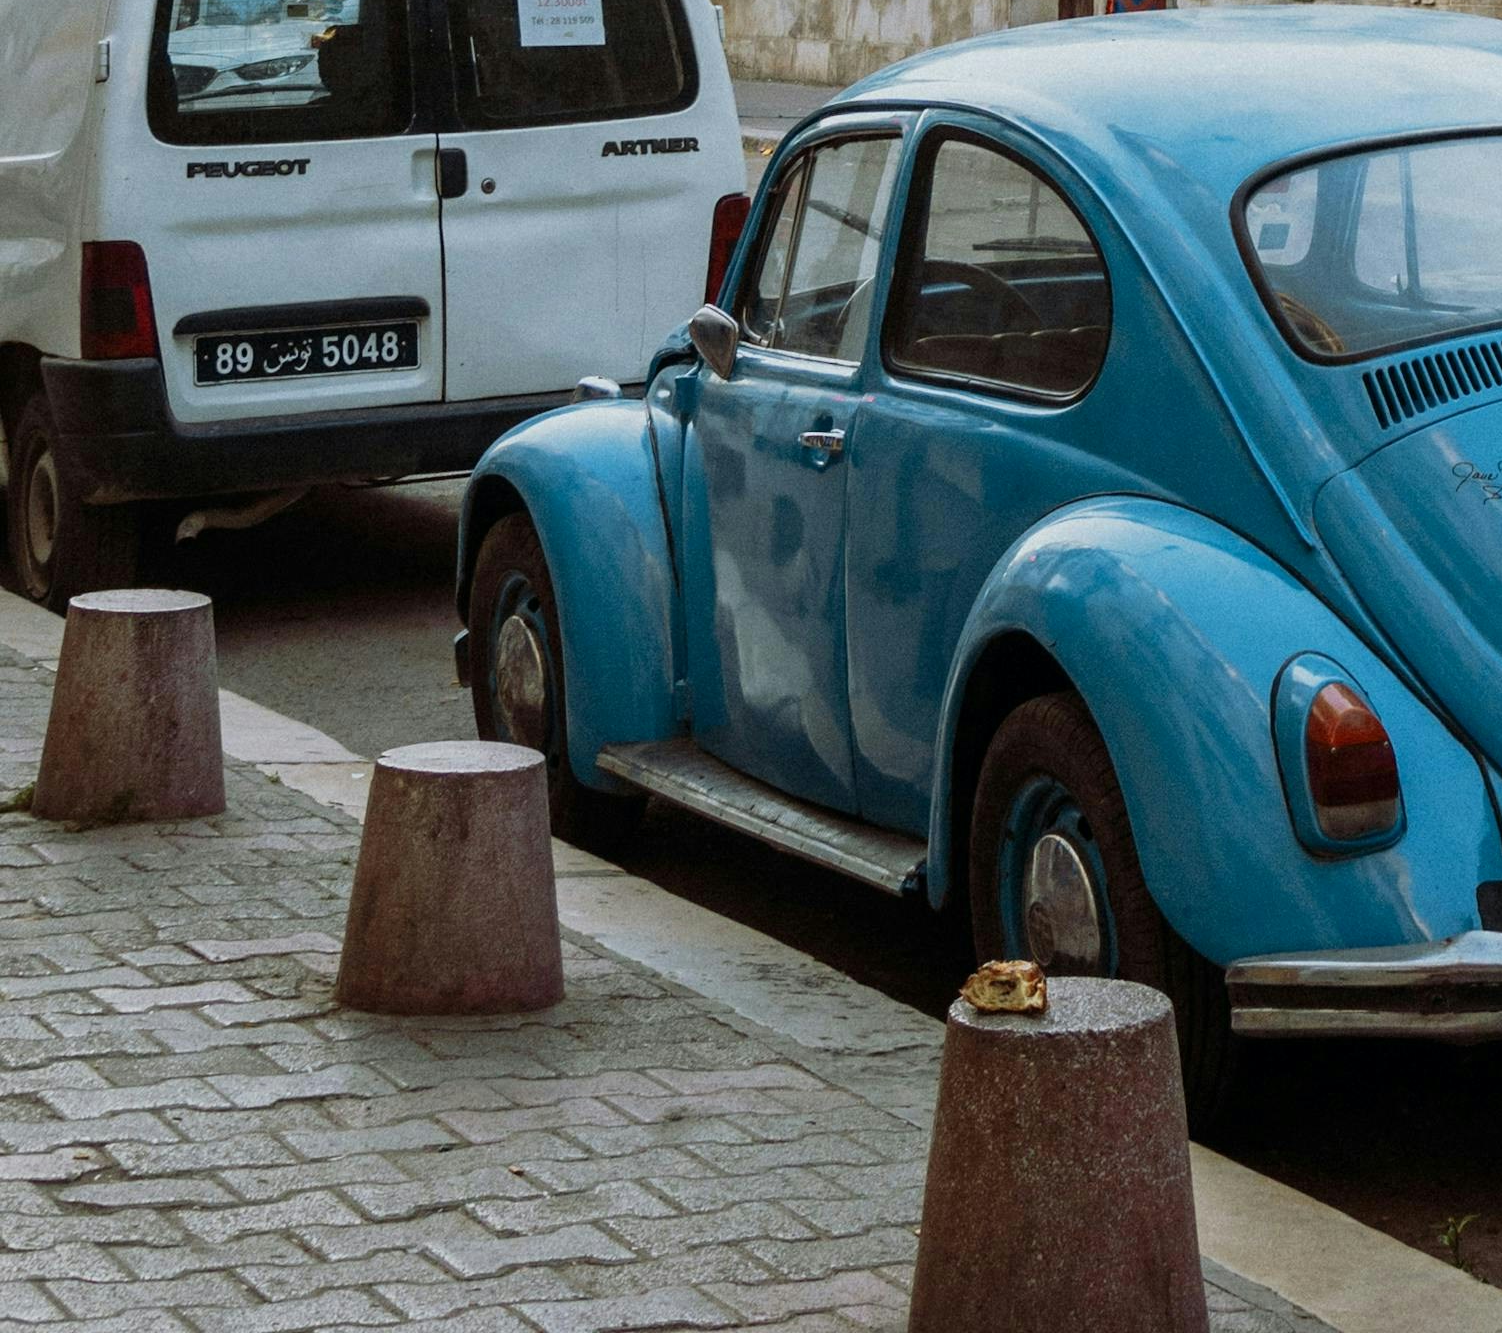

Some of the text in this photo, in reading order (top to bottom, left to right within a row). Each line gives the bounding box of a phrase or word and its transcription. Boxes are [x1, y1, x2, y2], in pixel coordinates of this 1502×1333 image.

[187, 158, 311, 178] PEUGEOT
[216, 331, 400, 375] 89 تونس 5048
